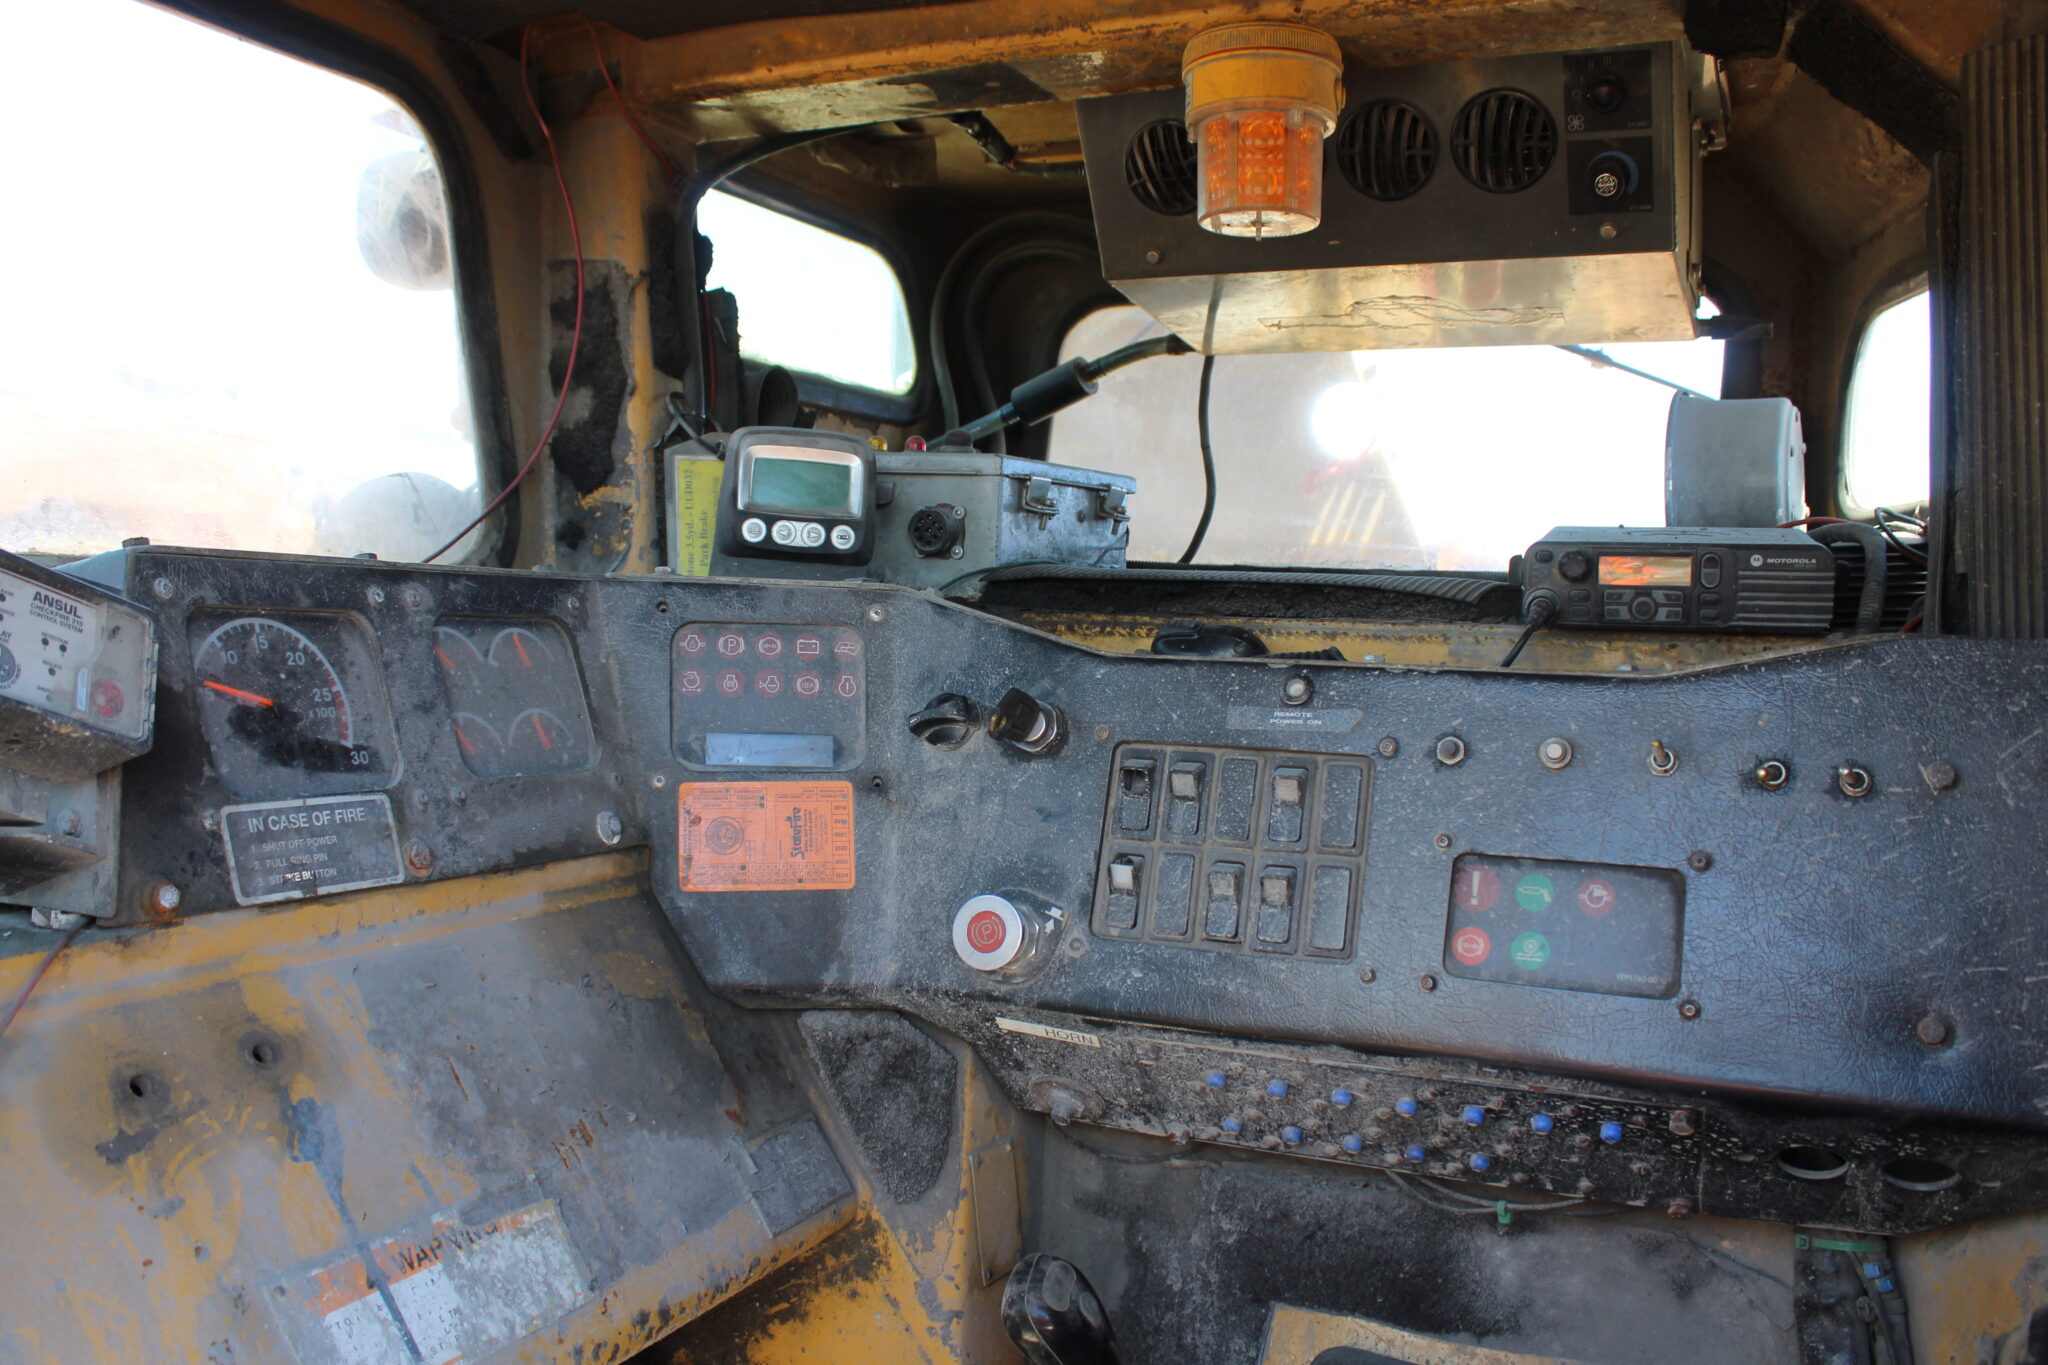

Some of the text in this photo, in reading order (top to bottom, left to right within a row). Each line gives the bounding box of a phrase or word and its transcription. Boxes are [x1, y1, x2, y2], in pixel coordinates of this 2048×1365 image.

[33, 591, 83, 619] ANSUL
[29, 609, 58, 625] CONTROL
[59, 621, 84, 634] SYSTEM
[30, 602, 70, 621] CHECKFIRE
[71, 618, 84, 627] 210
[251, 636, 269, 651] 15
[221, 651, 238, 665] 10
[286, 651, 305, 666] 20
[313, 688, 332, 702] 25
[350, 751, 369, 765] 30
[247, 807, 368, 833] IN CASE OF FIRE
[262, 840, 286, 853] SHUT
[306, 835, 338, 847] POWER
[266, 859, 288, 869] PULL
[313, 852, 328, 863] PIN
[1044, 1027, 1094, 1044] HORN
